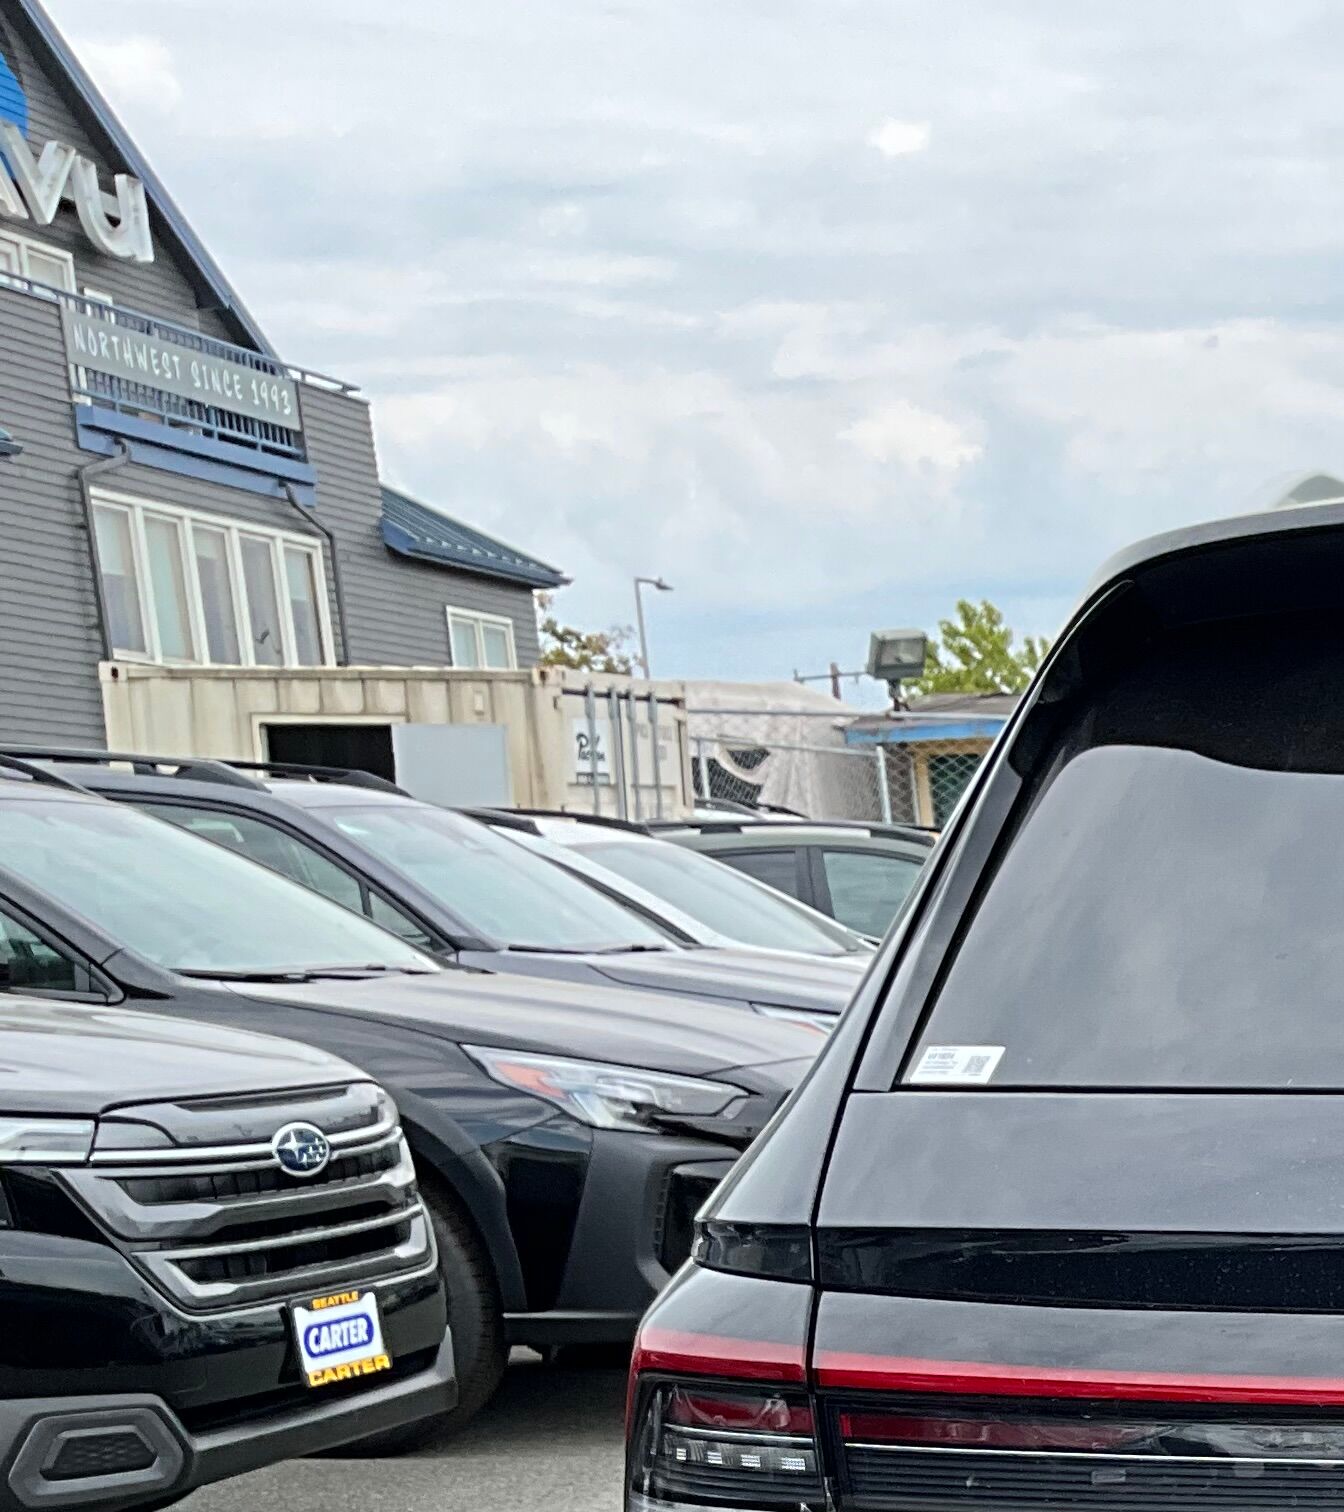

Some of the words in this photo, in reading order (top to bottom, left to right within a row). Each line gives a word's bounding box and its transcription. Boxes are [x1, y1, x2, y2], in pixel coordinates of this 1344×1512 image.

[73, 323, 181, 381] NORTHWEST
[190, 360, 244, 401] SINCE
[250, 379, 292, 416] 1993
[312, 1290, 359, 1310] SEATTLE
[308, 1317, 370, 1355] CARTER
[308, 1353, 391, 1388] CARTER
